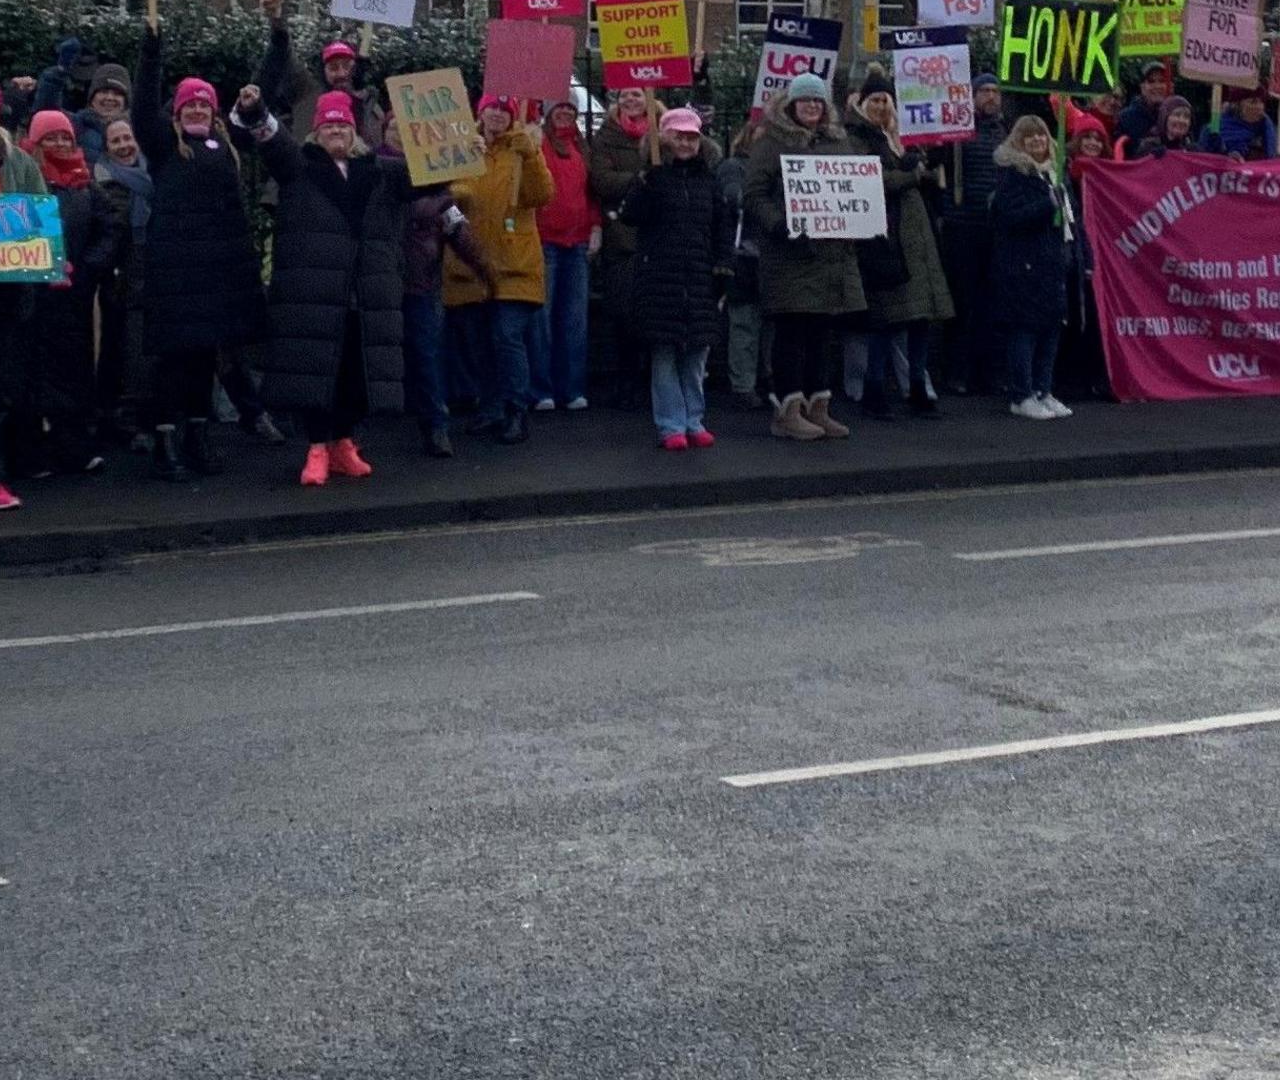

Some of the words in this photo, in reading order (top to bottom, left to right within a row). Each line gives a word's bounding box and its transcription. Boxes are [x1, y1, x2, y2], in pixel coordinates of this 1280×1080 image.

[602, 4, 679, 23] SUPPORT
[1208, 11, 1237, 36] FOR
[625, 26, 660, 38] OUR
[616, 42, 673, 58] STRIKE
[1001, 5, 1118, 88] HONK
[1185, 39, 1258, 70] EDUCATION
[905, 103, 936, 124] THE
[409, 119, 447, 147] PAY
[786, 160, 805, 173] IF
[815, 161, 878, 176] PASSION
[788, 179, 821, 194] PAID
[826, 180, 854, 193] THE
[790, 199, 832, 213] BILLS
[1114, 171, 1249, 259] KNOWLEDGE
[792, 217, 807, 232] BE
[814, 217, 846, 232] RICH
[1162, 255, 1233, 280] Eastern
[1238, 255, 1268, 278] and
[1168, 284, 1250, 310] Counties
